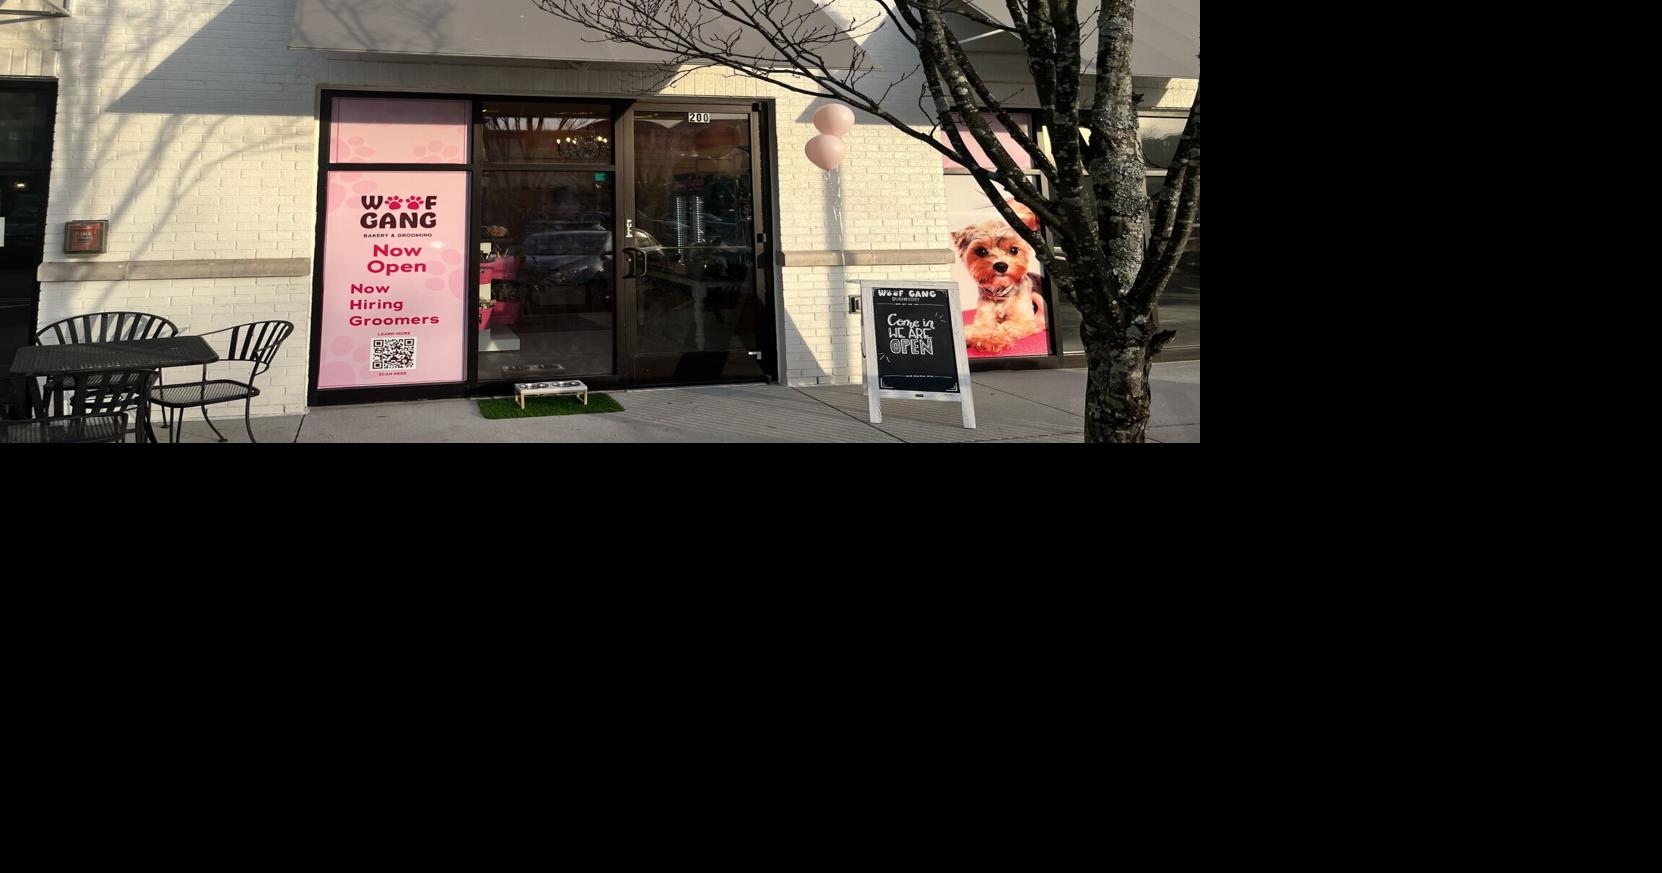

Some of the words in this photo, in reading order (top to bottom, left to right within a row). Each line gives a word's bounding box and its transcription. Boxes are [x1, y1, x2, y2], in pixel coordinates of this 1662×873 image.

[689, 113, 709, 122] 200
[360, 212, 437, 229] GANG
[373, 244, 422, 257] Now
[367, 260, 426, 276] Open
[350, 283, 390, 294] Now
[350, 299, 403, 311] Hiring
[349, 315, 439, 326] Groomers
[887, 313, 920, 328] Come
[922, 318, 935, 329] in
[888, 327, 905, 339] WE
[908, 327, 932, 339] ARE
[889, 338, 934, 355] OPEN
